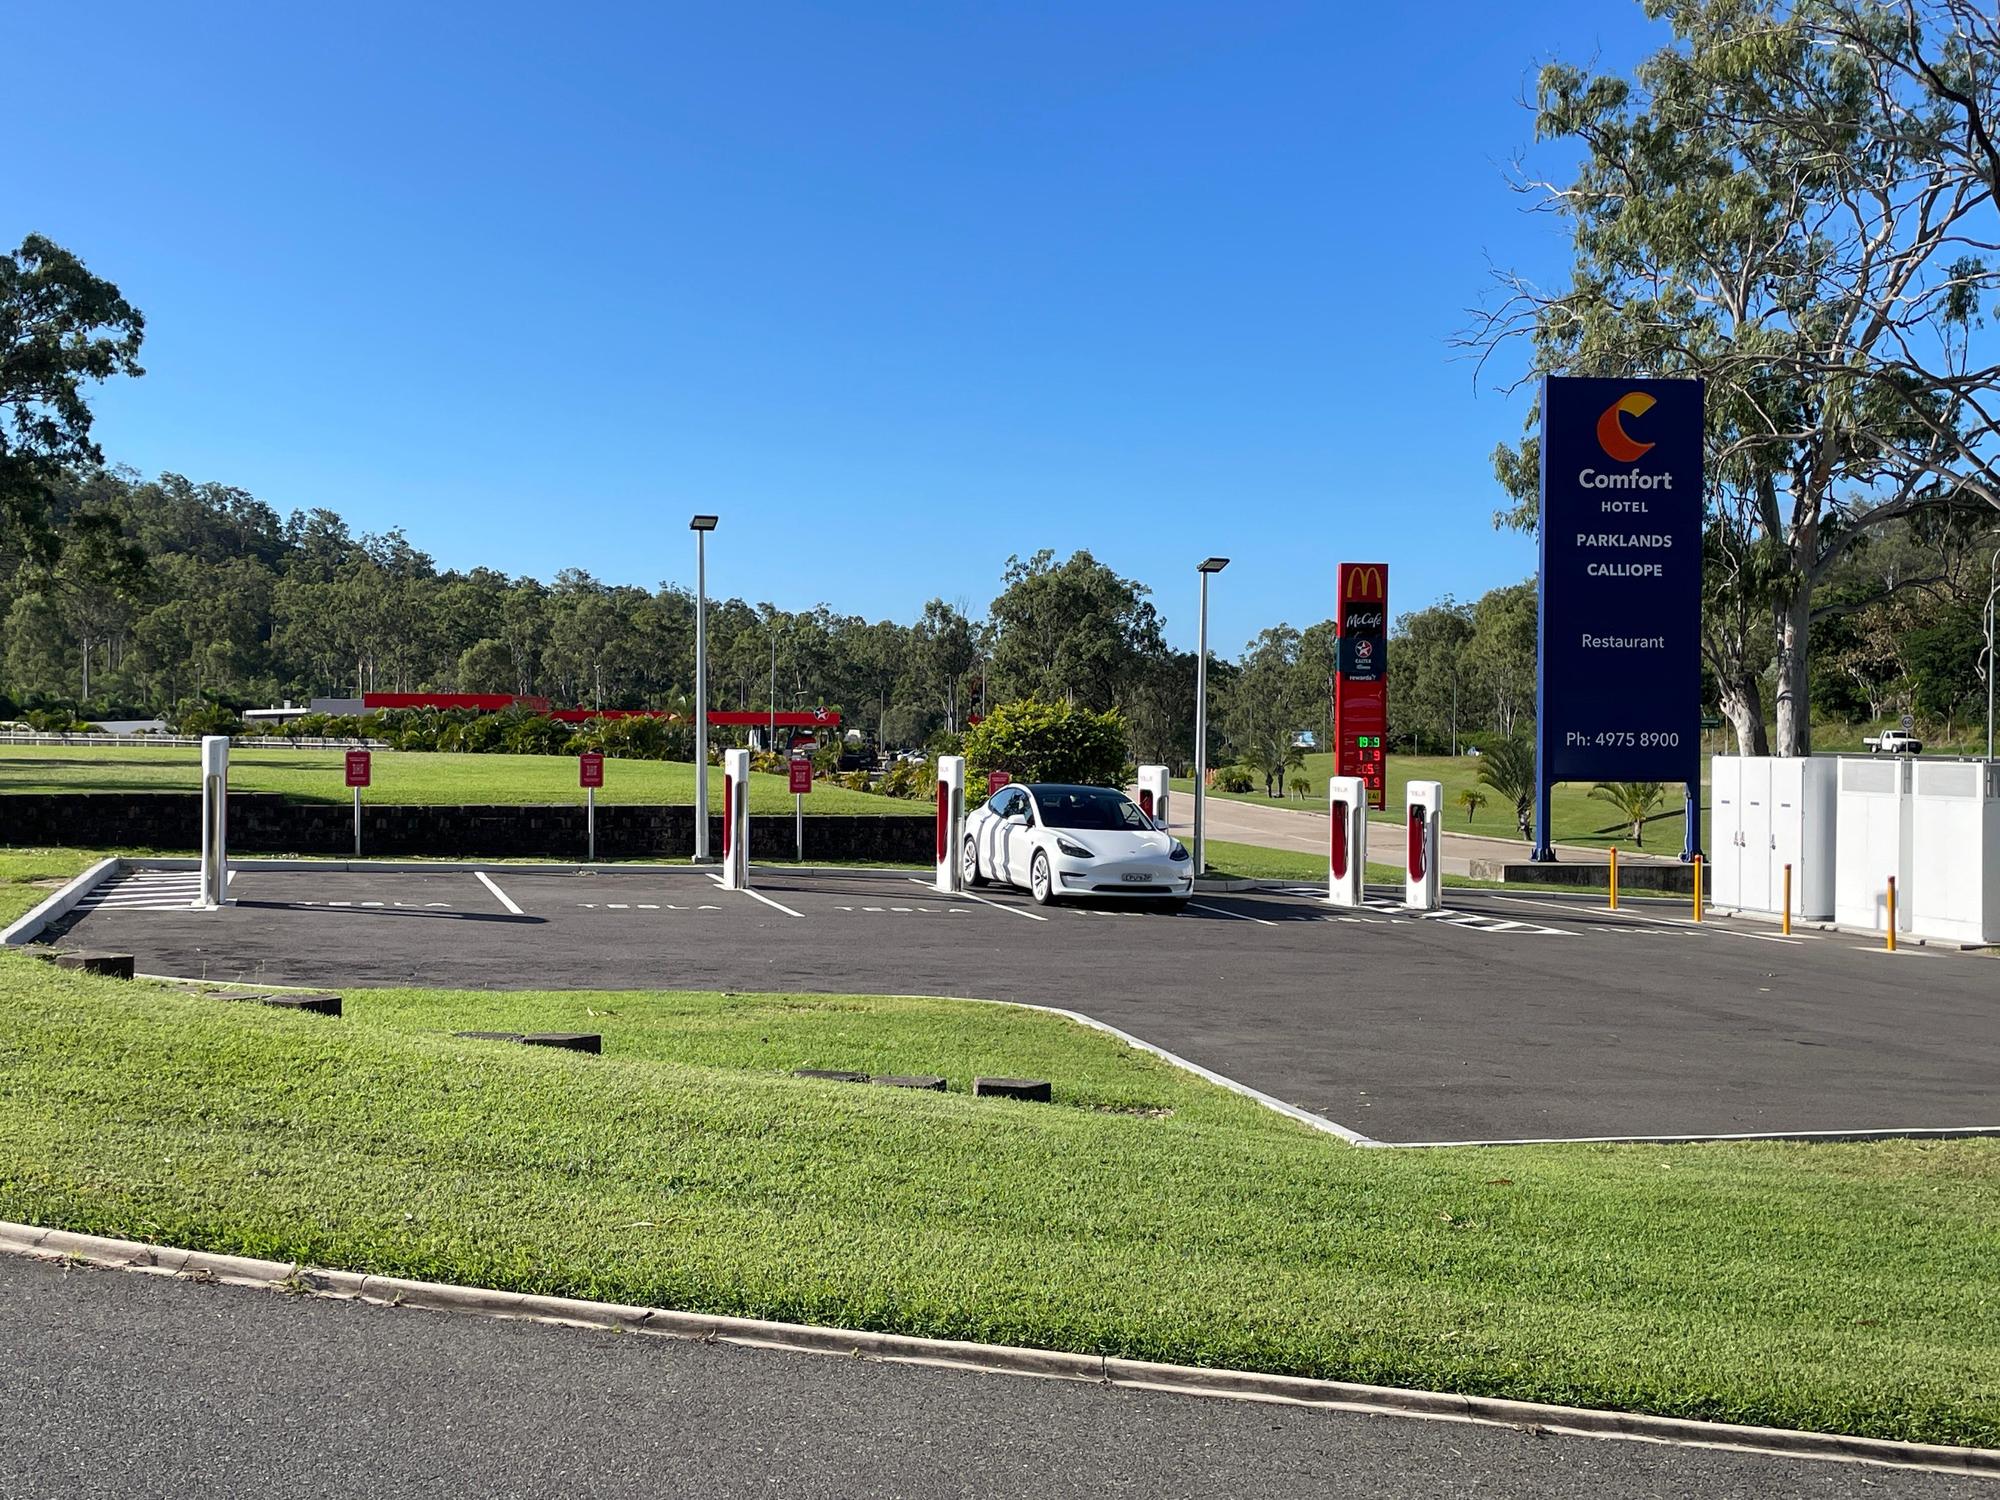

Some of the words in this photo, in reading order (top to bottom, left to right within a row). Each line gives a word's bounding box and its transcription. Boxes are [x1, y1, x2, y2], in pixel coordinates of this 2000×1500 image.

[1579, 468, 1673, 490] Comfort
[1601, 501, 1649, 513] HOTEL
[1576, 533, 1673, 548] PARKLANDS
[1586, 563, 1663, 577] CALLIOPE
[1581, 633, 1665, 649] Restaurant
[1566, 731, 1591, 746] Ph:
[1595, 732, 1635, 747] 4975
[1639, 732, 1680, 747] 8900
